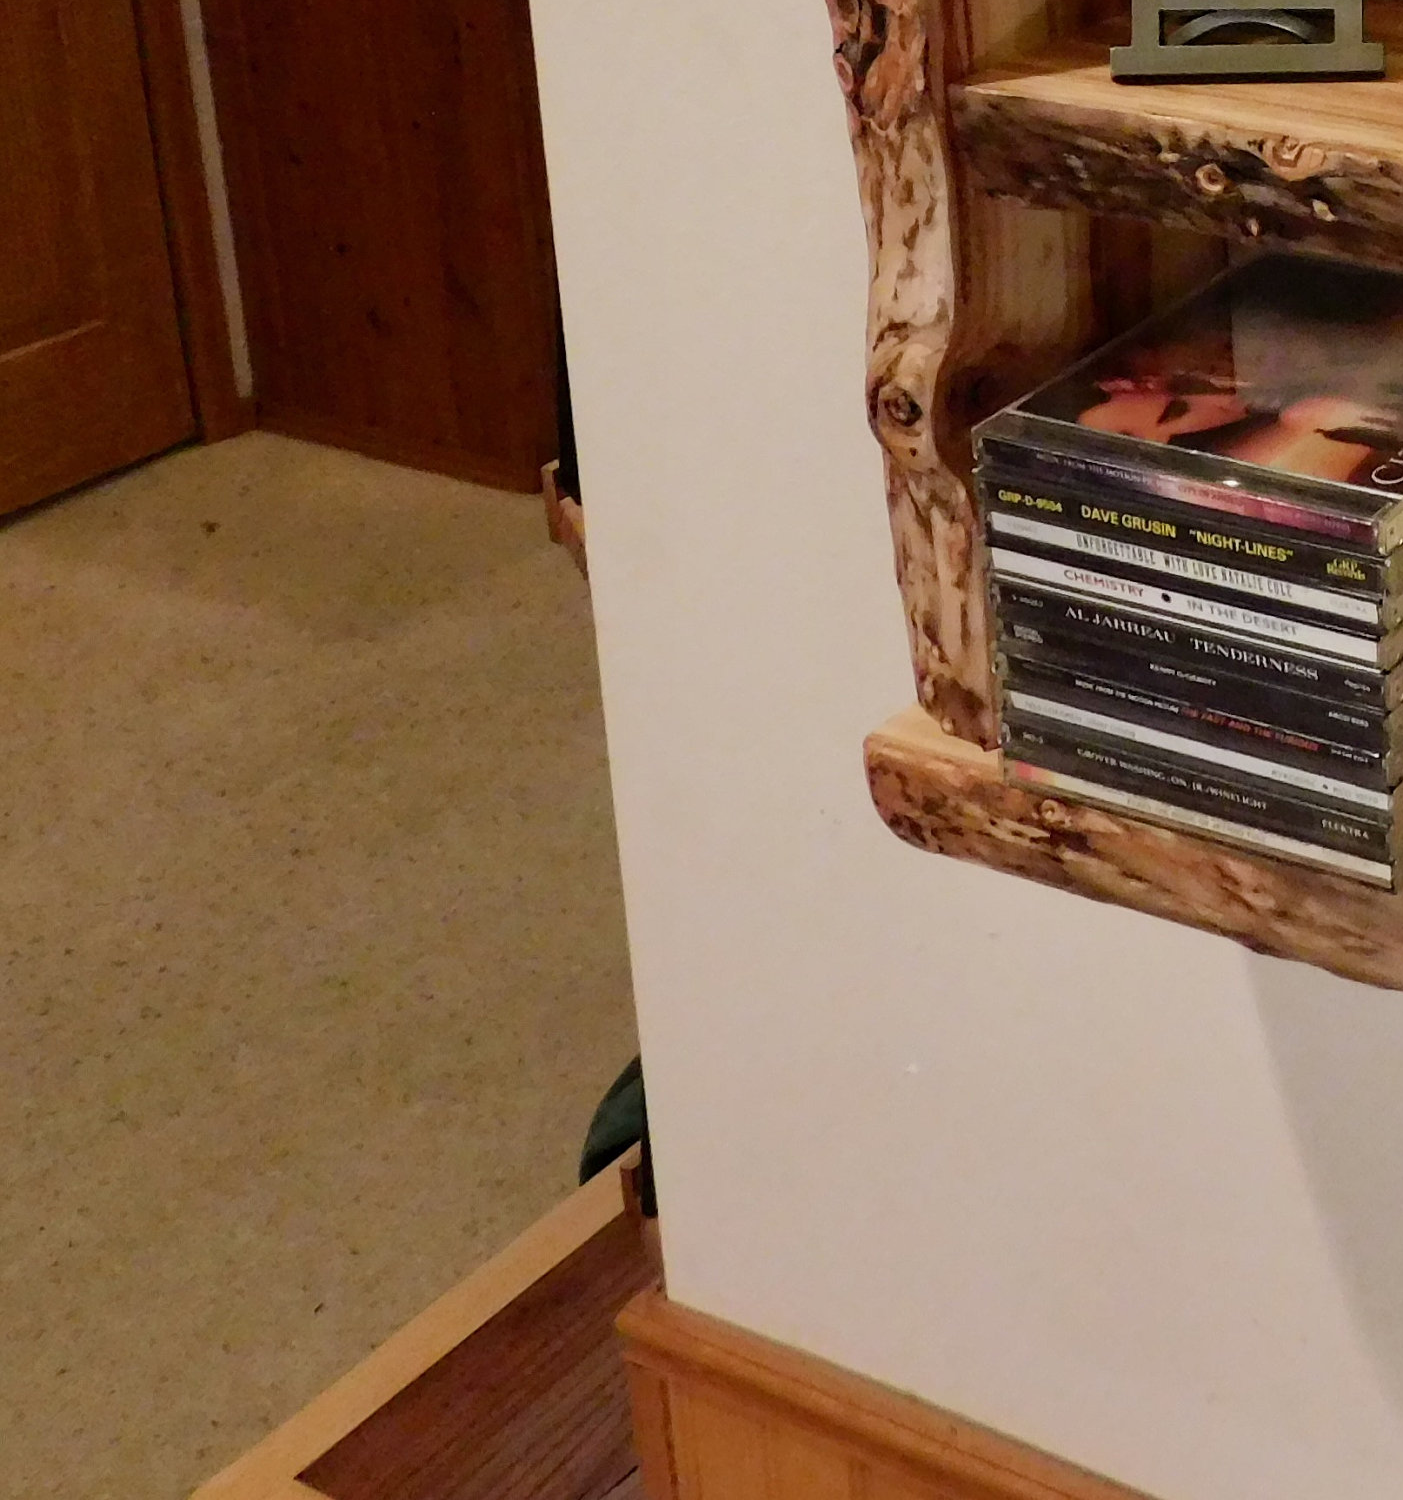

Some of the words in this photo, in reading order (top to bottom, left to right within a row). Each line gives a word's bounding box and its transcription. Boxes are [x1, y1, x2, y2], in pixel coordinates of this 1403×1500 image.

[1081, 504, 1119, 525] DAVE
[1121, 514, 1177, 538] GRUSIN
[1189, 529, 1294, 562] "NIGHT-LINES"
[1063, 569, 1144, 597] CHEMISTRY
[1076, 533, 1157, 565] UNFORGETTABLE
[1164, 554, 1188, 571] WITH
[1221, 568, 1264, 591] NATALIE
[1267, 578, 1293, 598] COLE
[1187, 599, 1203, 612] IN
[1209, 603, 1237, 620] THE
[1242, 612, 1299, 636] DESERT
[1065, 606, 1089, 622] AL
[1092, 613, 1176, 643] JARREAU
[1190, 638, 1319, 681] TENDERNESS
[1321, 819, 1370, 840] ELEKTRA
